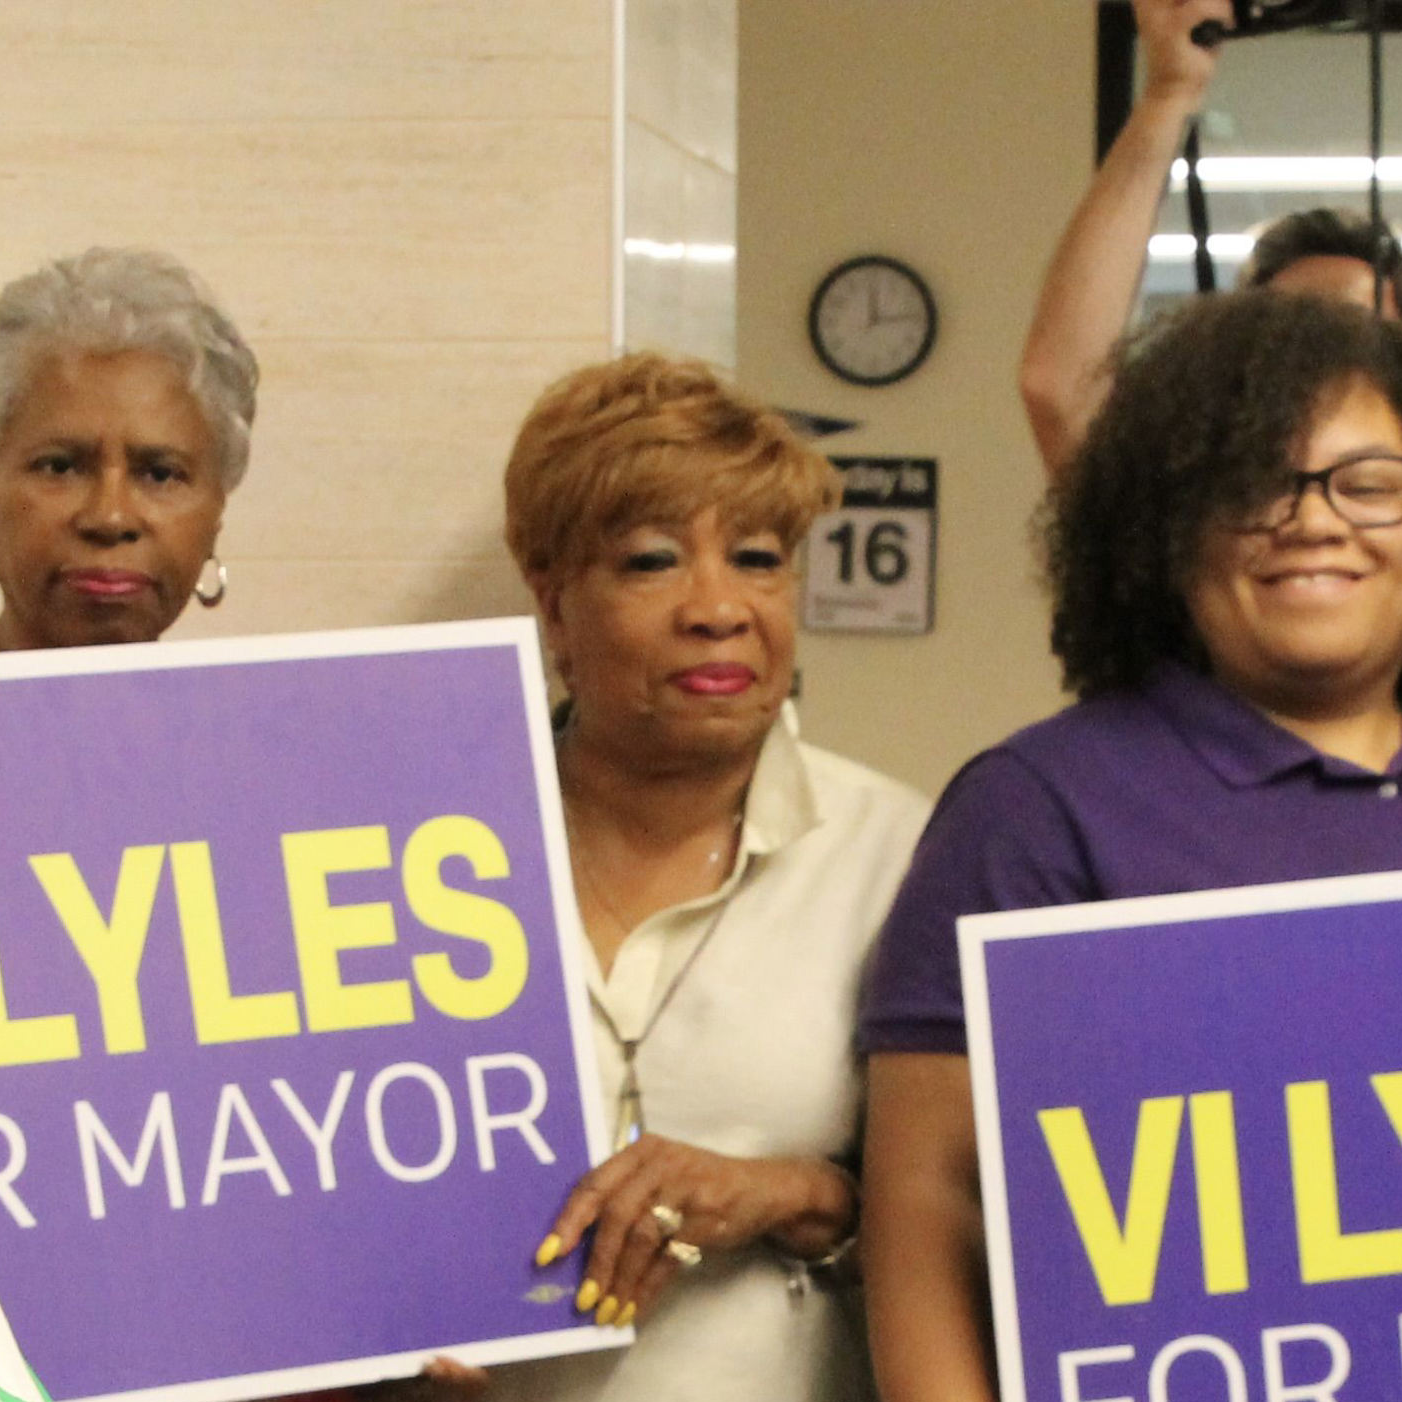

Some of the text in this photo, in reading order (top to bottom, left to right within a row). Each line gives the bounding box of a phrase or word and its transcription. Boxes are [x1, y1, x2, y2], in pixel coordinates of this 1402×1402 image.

[827, 520, 910, 585] 16
[73, 1051, 557, 1221] MAYOR
[1036, 1090, 1249, 1307] VI
